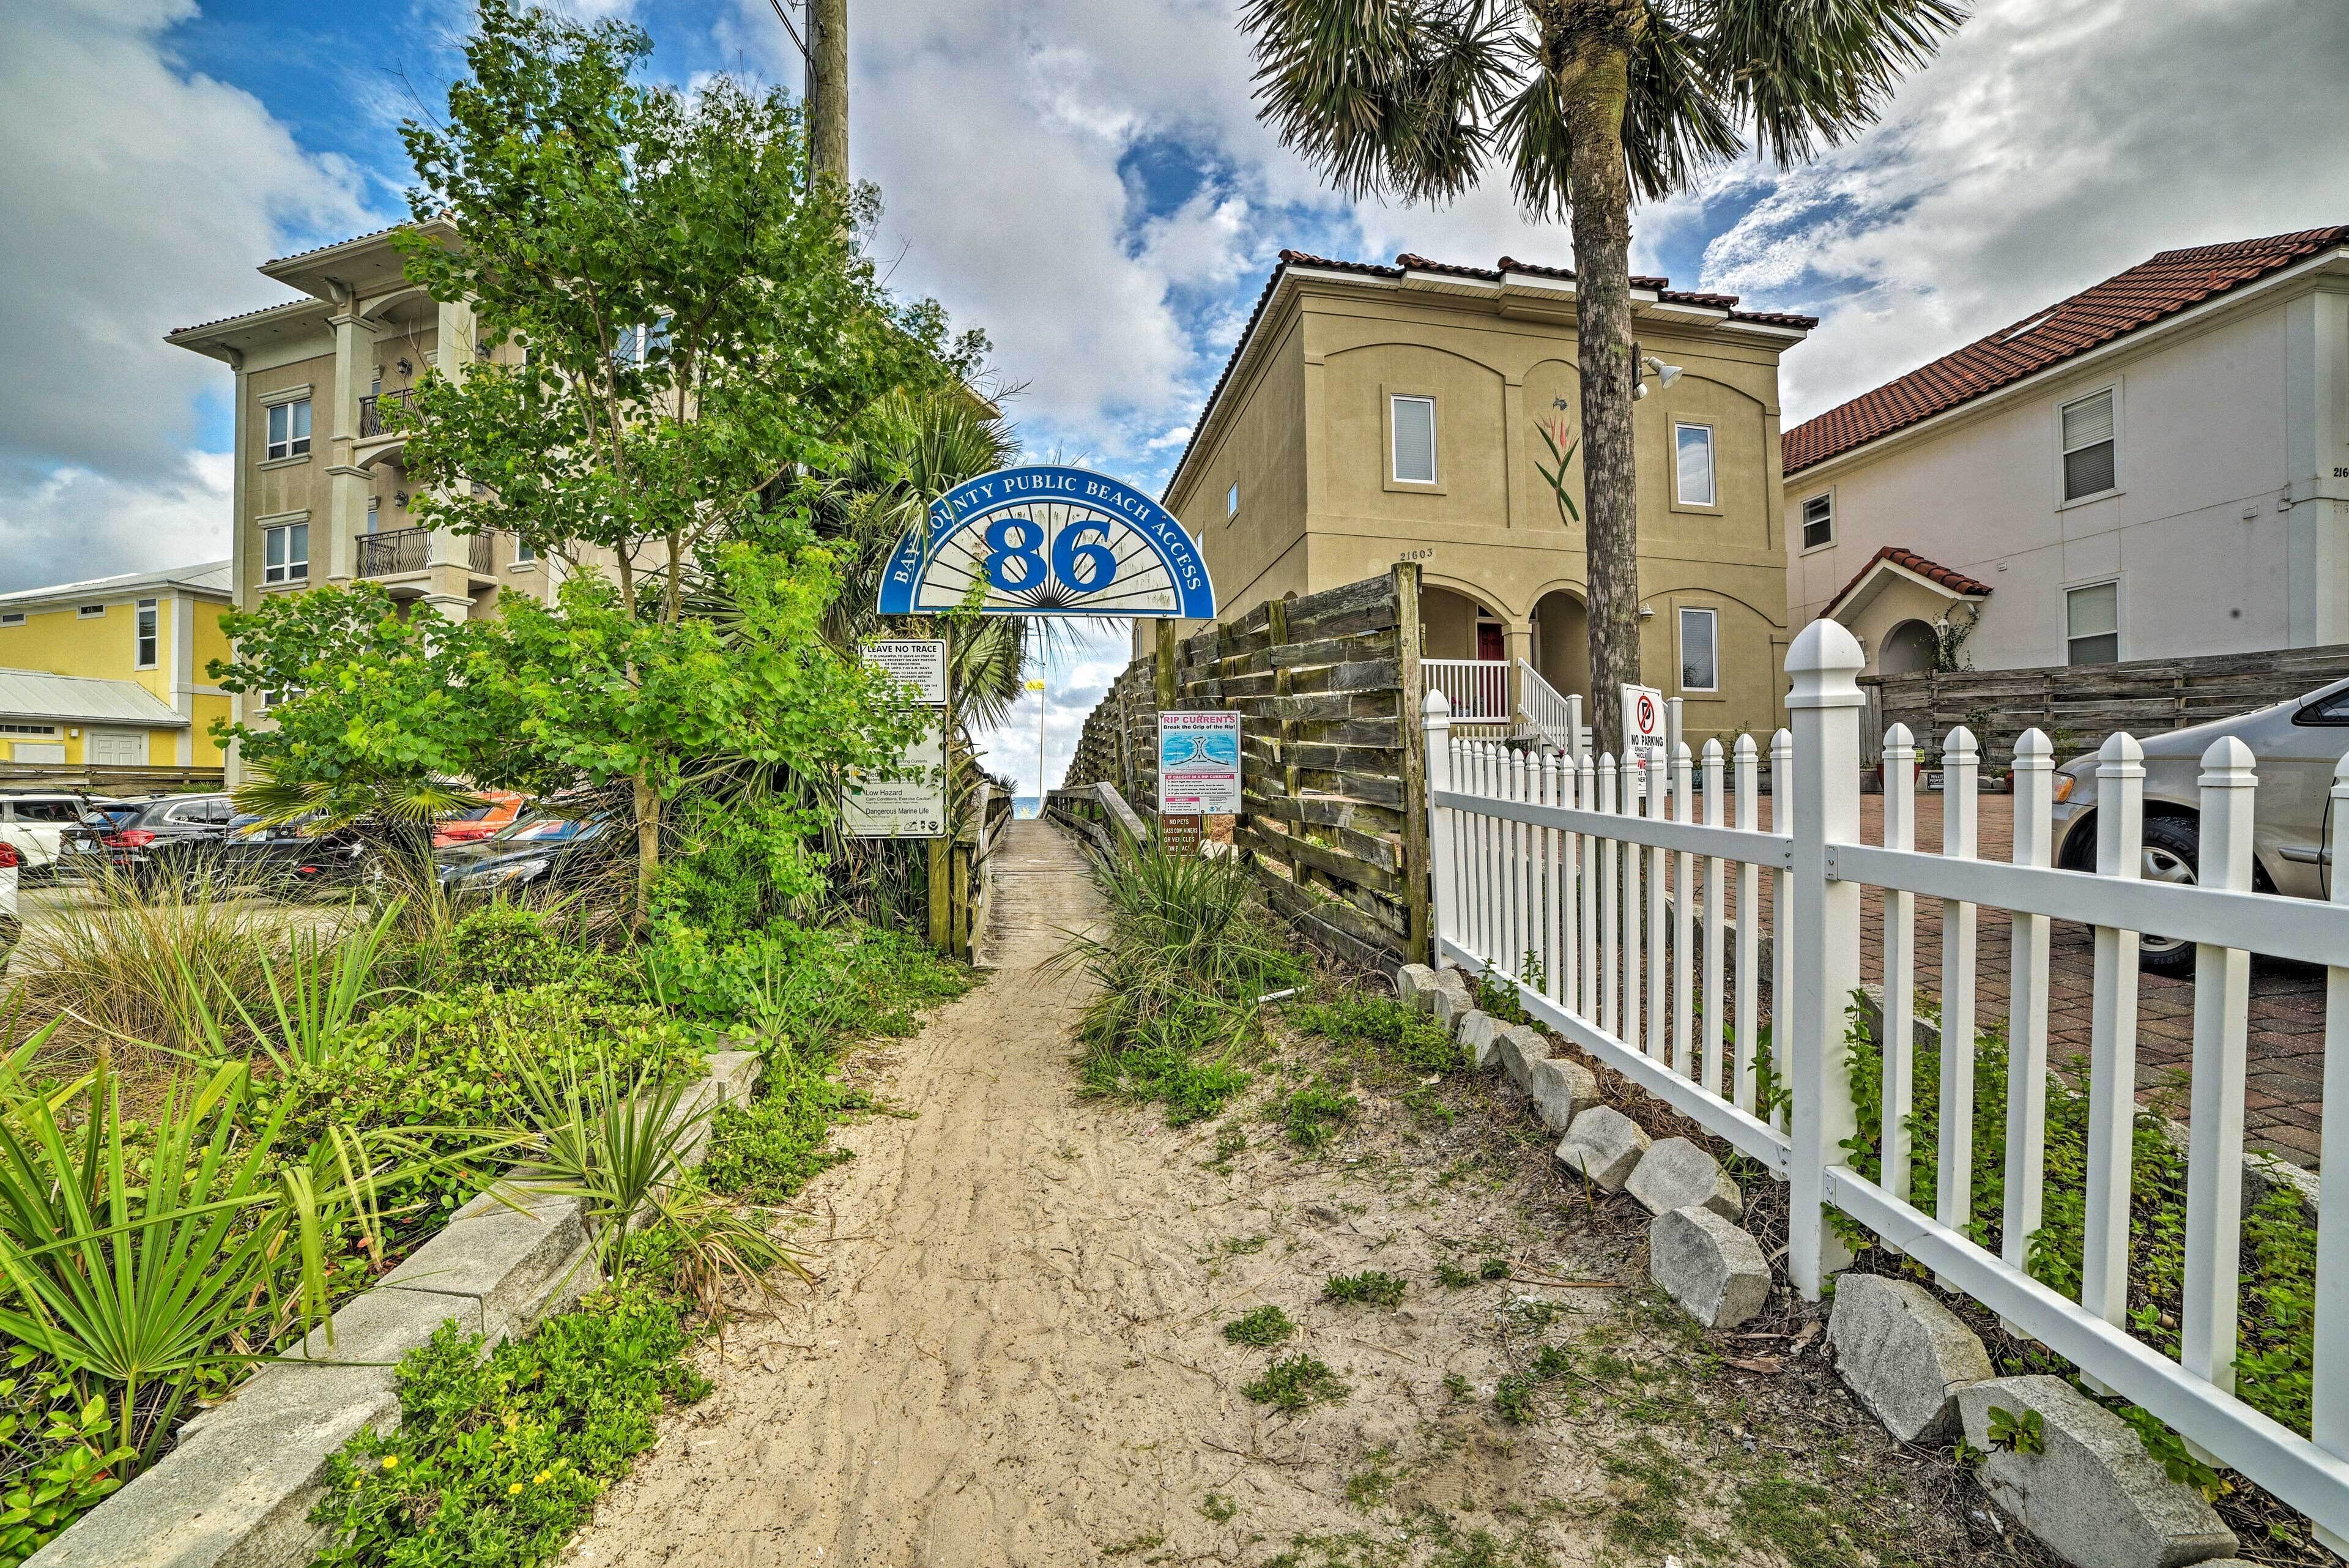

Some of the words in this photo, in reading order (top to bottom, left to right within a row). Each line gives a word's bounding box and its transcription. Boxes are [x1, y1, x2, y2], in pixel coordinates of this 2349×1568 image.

[1003, 474, 1077, 492] PUBLIC
[1085, 480, 1151, 521] BEACH
[1151, 522, 1201, 590] ACCESS
[985, 518, 1116, 592] 86
[1400, 548, 1433, 562] 21603
[1631, 734, 1639, 745] NO
[1641, 735, 1663, 747] PARKING
